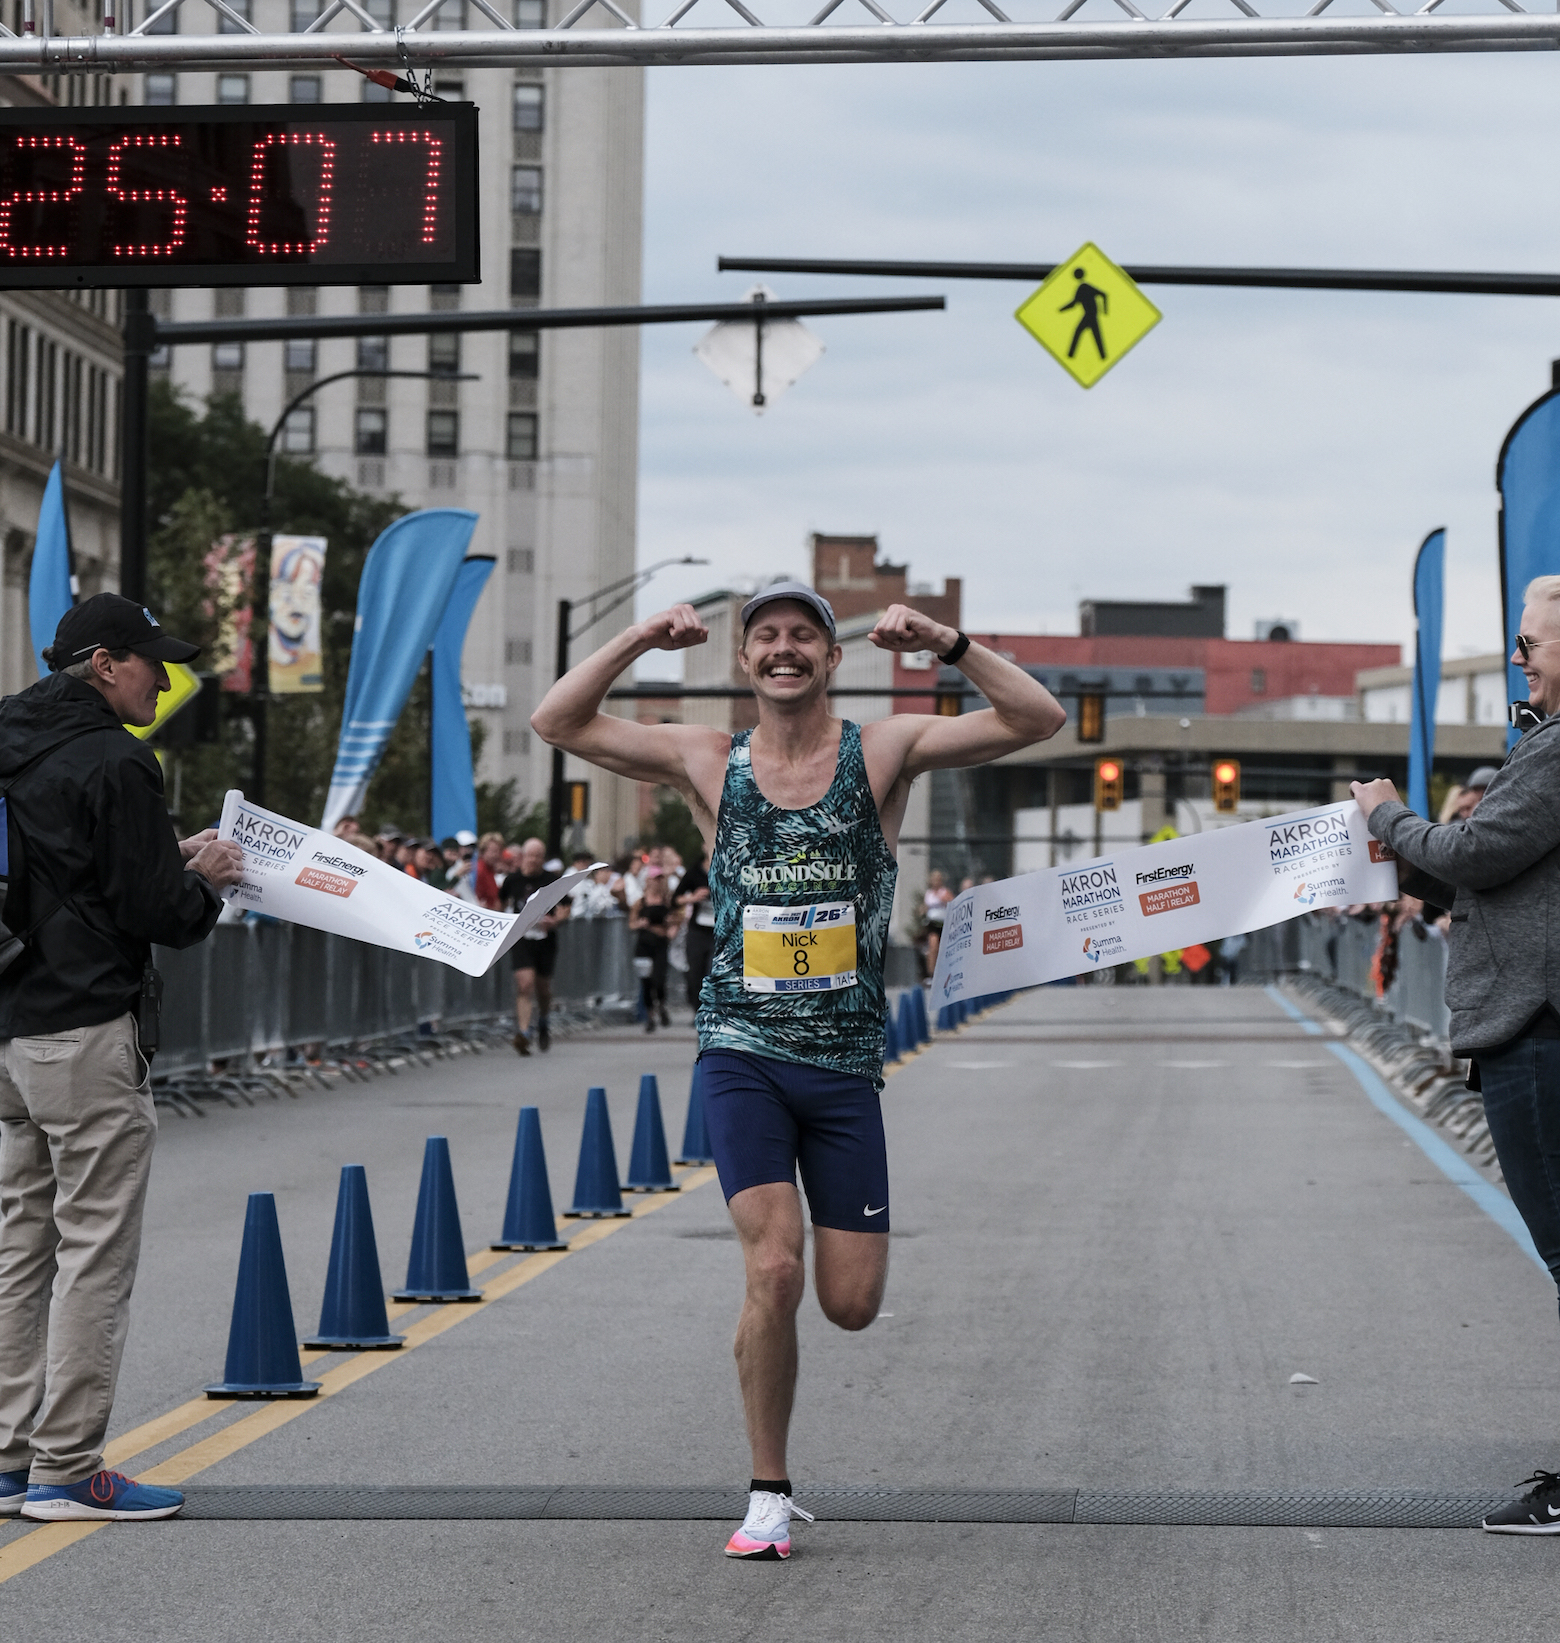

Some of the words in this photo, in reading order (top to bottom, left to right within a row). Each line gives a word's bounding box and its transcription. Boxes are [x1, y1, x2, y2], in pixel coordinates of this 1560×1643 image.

[235, 813, 304, 850] AKRON
[1269, 813, 1347, 847] AKRON
[232, 828, 295, 860] MARATHON
[1270, 830, 1350, 861] MARATHON
[252, 857, 286, 871] SERIES
[1273, 860, 1306, 875] RACE
[1312, 847, 1353, 864] SERIES
[307, 871, 349, 887] MARATHON
[1061, 867, 1117, 896] AKRON
[1293, 865, 1329, 880] PRESENTED
[300, 877, 321, 887] HALF
[323, 883, 348, 894] RELAY
[1146, 886, 1190, 903] MARATHON
[1307, 877, 1346, 892] Summa
[1062, 886, 1121, 909] MARATHON
[1145, 901, 1166, 913] HALF
[1170, 894, 1195, 906] RELAY
[430, 907, 500, 939] MARATHON
[438, 902, 510, 931] AKRON
[1066, 912, 1089, 924] RACE
[1092, 903, 1125, 918] SERIES
[422, 913, 451, 929] RACE
[454, 929, 491, 947] SERIES
[782, 932, 818, 947] Nick
[989, 928, 1018, 941] MARATHON
[428, 935, 462, 955] Summa
[986, 941, 1001, 951] HALF
[1004, 937, 1020, 948] RELAY
[1091, 935, 1122, 949] Summa
[793, 949, 810, 976] 8
[785, 979, 820, 991] SERIES
